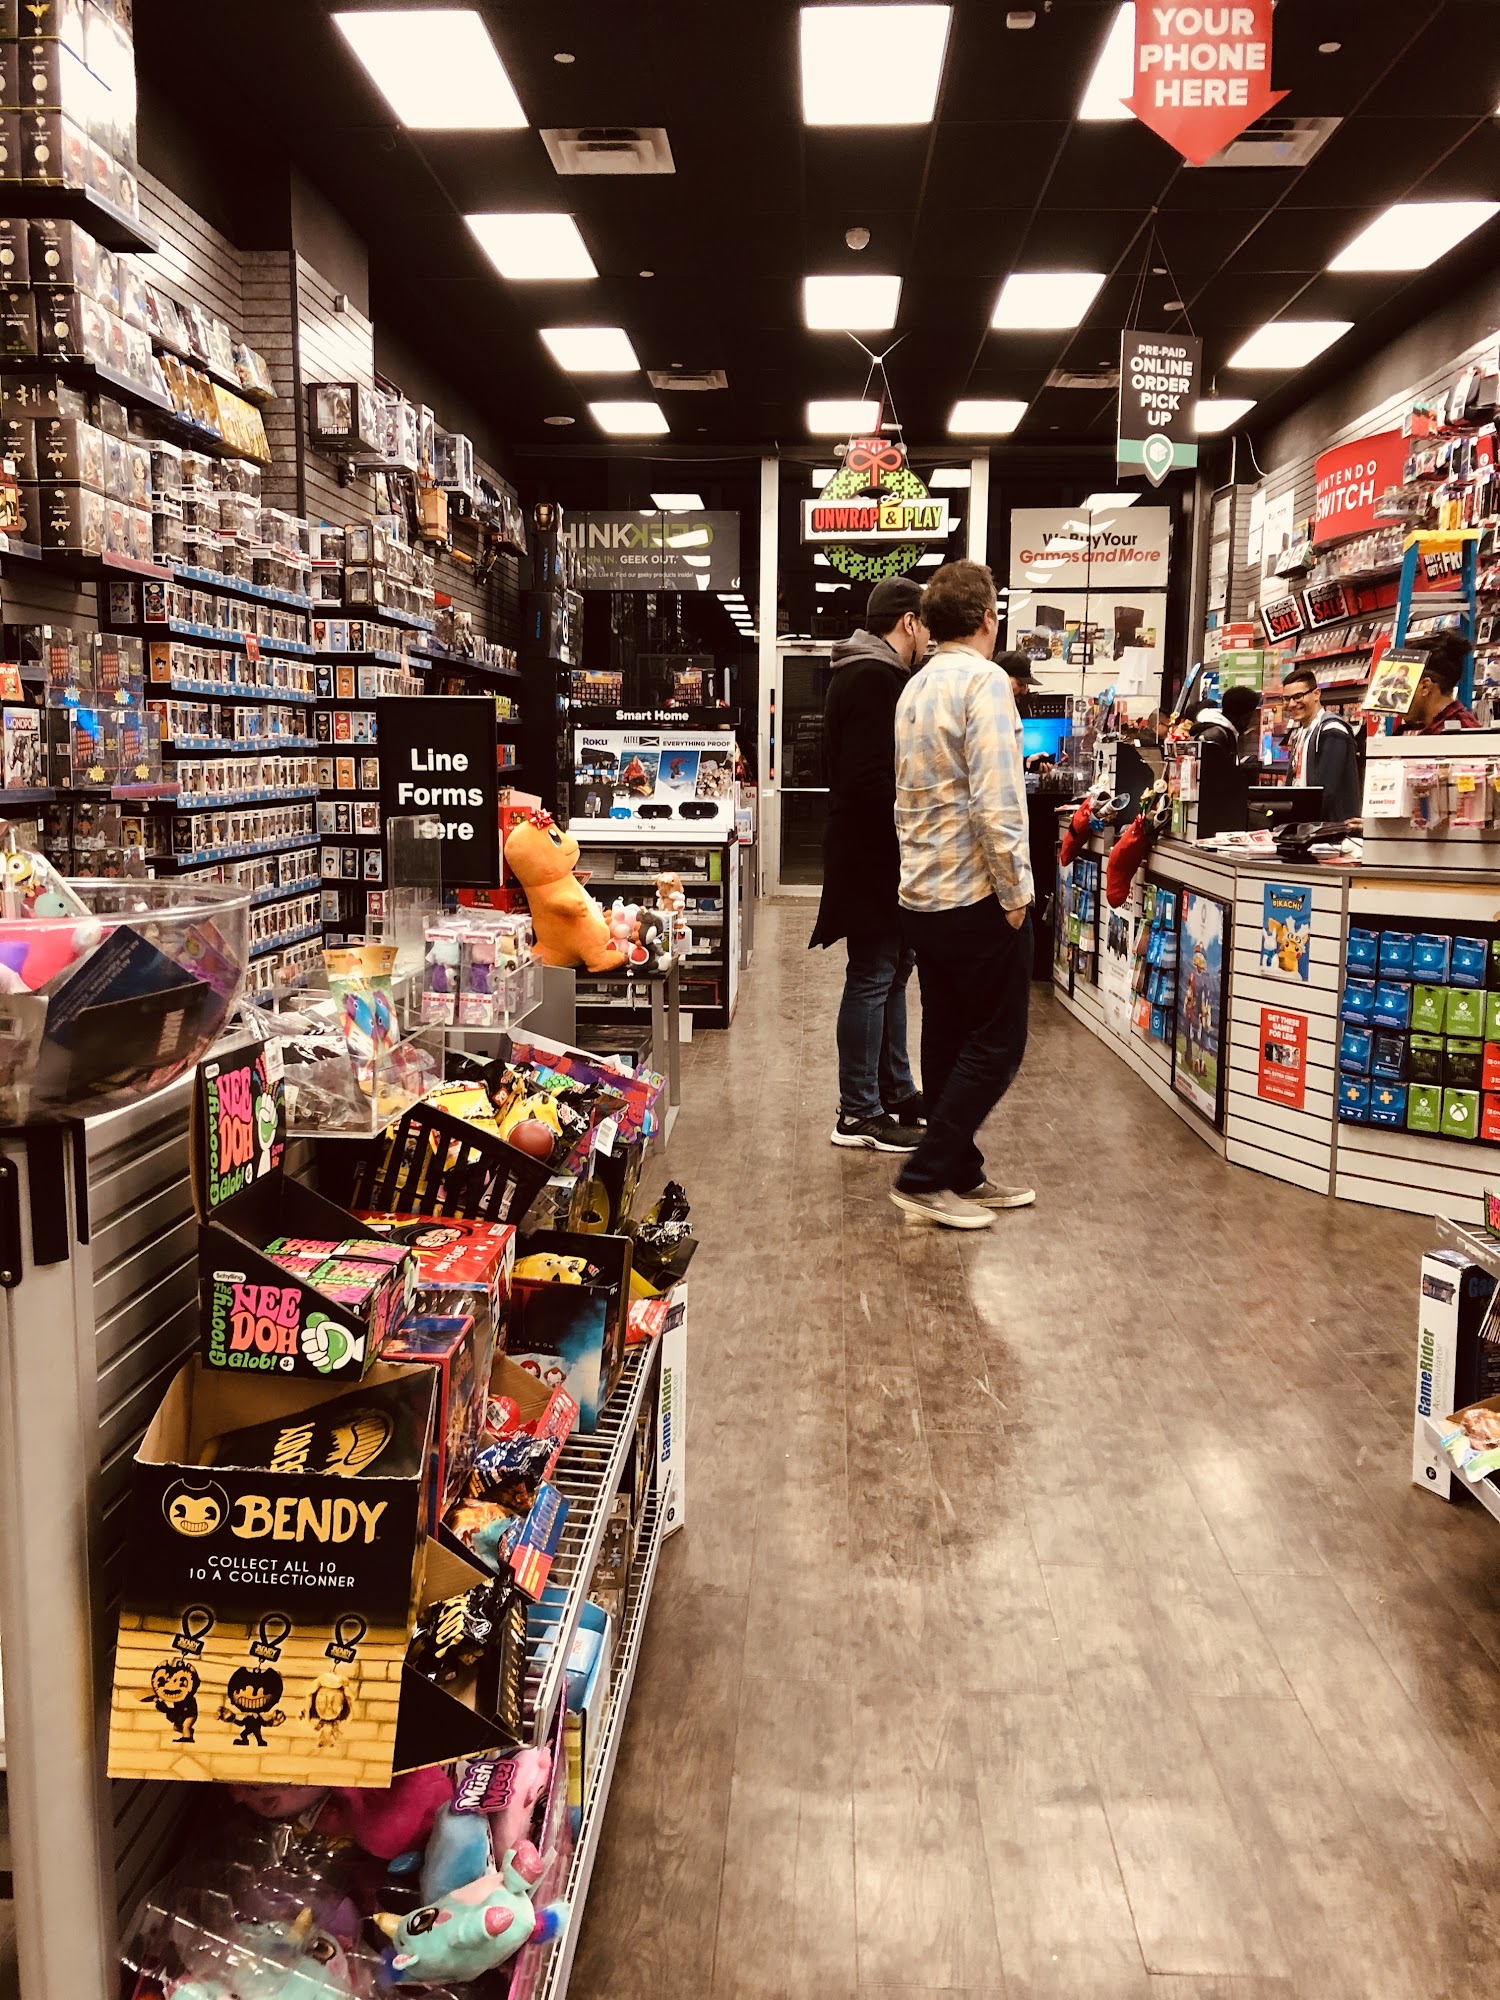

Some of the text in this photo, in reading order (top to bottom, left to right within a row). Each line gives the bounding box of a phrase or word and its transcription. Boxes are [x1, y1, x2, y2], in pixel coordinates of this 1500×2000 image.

[1152, 7, 1255, 36] YOUR
[1139, 42, 1266, 72] PHONE
[1155, 78, 1249, 107] HERE
[1138, 344, 1187, 359] PRE-PAID
[1130, 356, 1193, 376] ONLINE
[1131, 374, 1190, 393] ORDER
[1140, 392, 1180, 410] PICK
[1147, 410, 1172, 426] UP
[321, 427, 349, 435] SPIDER-MAN
[1316, 460, 1377, 493] NINTENDO
[1316, 479, 1376, 522] SWITCH
[812, 506, 943, 532] UNWRAP & PLAY
[561, 523, 631, 548] HINK
[1102, 532, 1138, 546] Your
[620, 555, 648, 564] GEEK
[1019, 548, 1161, 564] Games and More
[1313, 599, 1345, 622] SALE
[1271, 611, 1301, 634] SALE
[7, 716, 37, 731] MONOPO
[616, 709, 689, 721] Smart Home
[411, 748, 468, 772] Line
[398, 782, 484, 806] Forms
[1272, 899, 1303, 912] PIKACHU
[1267, 1013, 1300, 1027] GET THESE
[1272, 1022, 1294, 1034] GAMES
[1268, 1029, 1297, 1042] FOR LESS
[216, 1066, 252, 1123] NEE
[219, 1115, 254, 1175] DOH
[219, 1166, 245, 1201] Glob!
[281, 1241, 333, 1254] DOH
[215, 1272, 244, 1282] Schylling
[329, 1265, 383, 1279] DOH
[214, 1283, 232, 1294] The
[230, 1284, 302, 1328] NEE
[209, 1291, 233, 1366] Groovy
[230, 1312, 299, 1355] DOH
[228, 1352, 278, 1370] Glob!
[1418, 1328, 1435, 1417] GameRider
[661, 1367, 672, 1463] GameRider
[231, 1494, 388, 1544] BENDY
[208, 1555, 336, 1574] COLLECT ALL 10
[189, 1568, 355, 1588] 10 A COLLECTIONNER
[459, 1763, 495, 1808] Müsh
[482, 1763, 515, 1807] Meez
